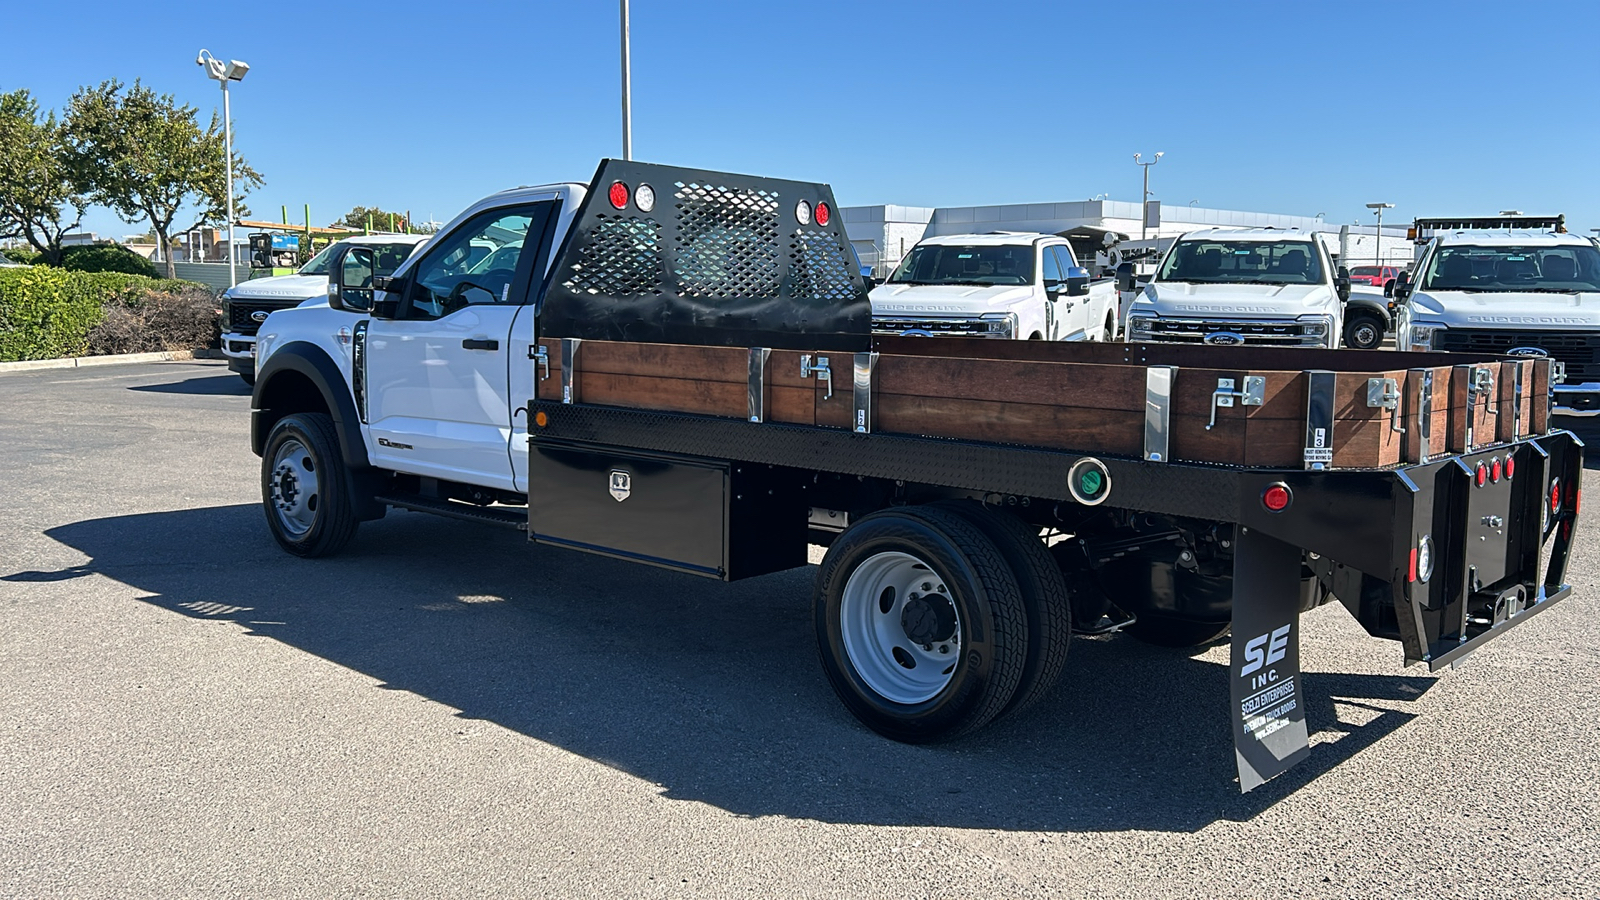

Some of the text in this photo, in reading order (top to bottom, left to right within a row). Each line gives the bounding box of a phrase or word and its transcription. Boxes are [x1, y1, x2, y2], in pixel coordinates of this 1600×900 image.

[1175, 304, 1281, 313] SUPER DUTY
[1467, 315, 1591, 324] SUPER DUTY
[1240, 623, 1291, 678] SE
[1252, 669, 1279, 690] INC.
[1241, 680, 1295, 716] SCELZI ENTERPRISES
[1265, 707, 1281, 722] TRUCK
[1280, 699, 1297, 715] BODIES
